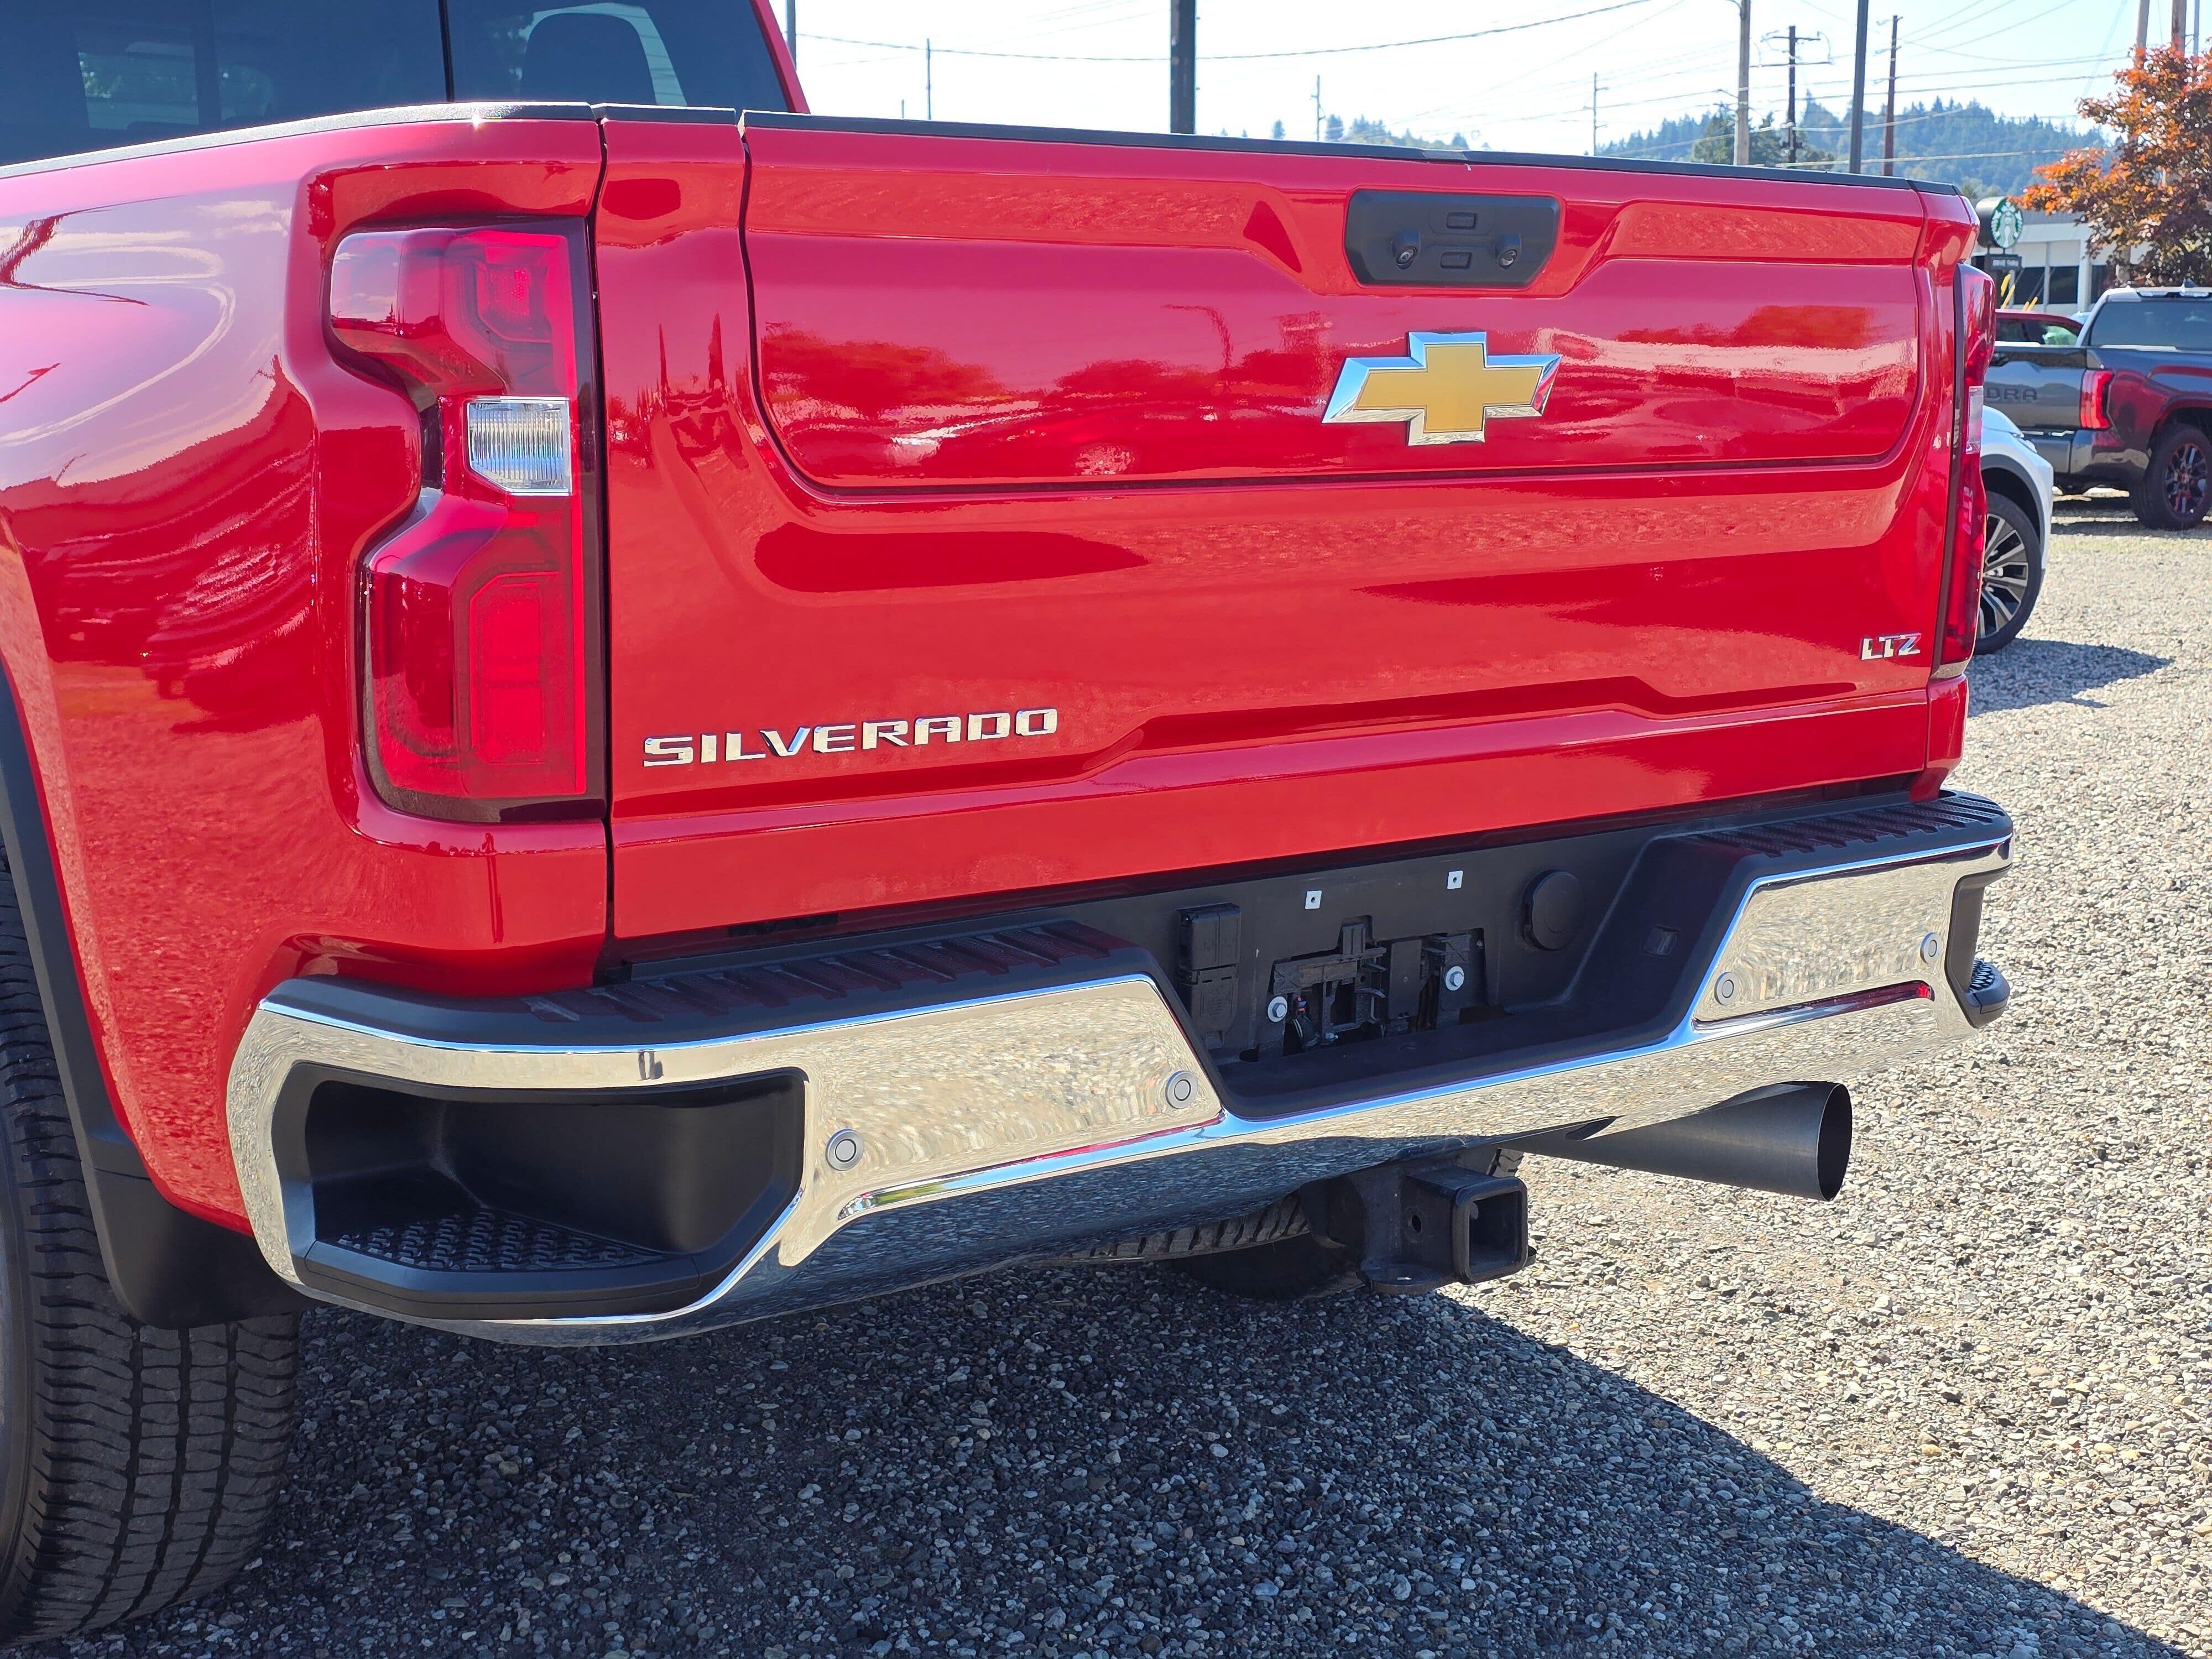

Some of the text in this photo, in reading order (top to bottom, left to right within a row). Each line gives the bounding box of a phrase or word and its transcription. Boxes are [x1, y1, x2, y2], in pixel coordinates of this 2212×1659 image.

[1986, 388, 2037, 400] DRA
[1860, 633, 1922, 660] LTZ
[643, 708, 1058, 768] SILVERADO
